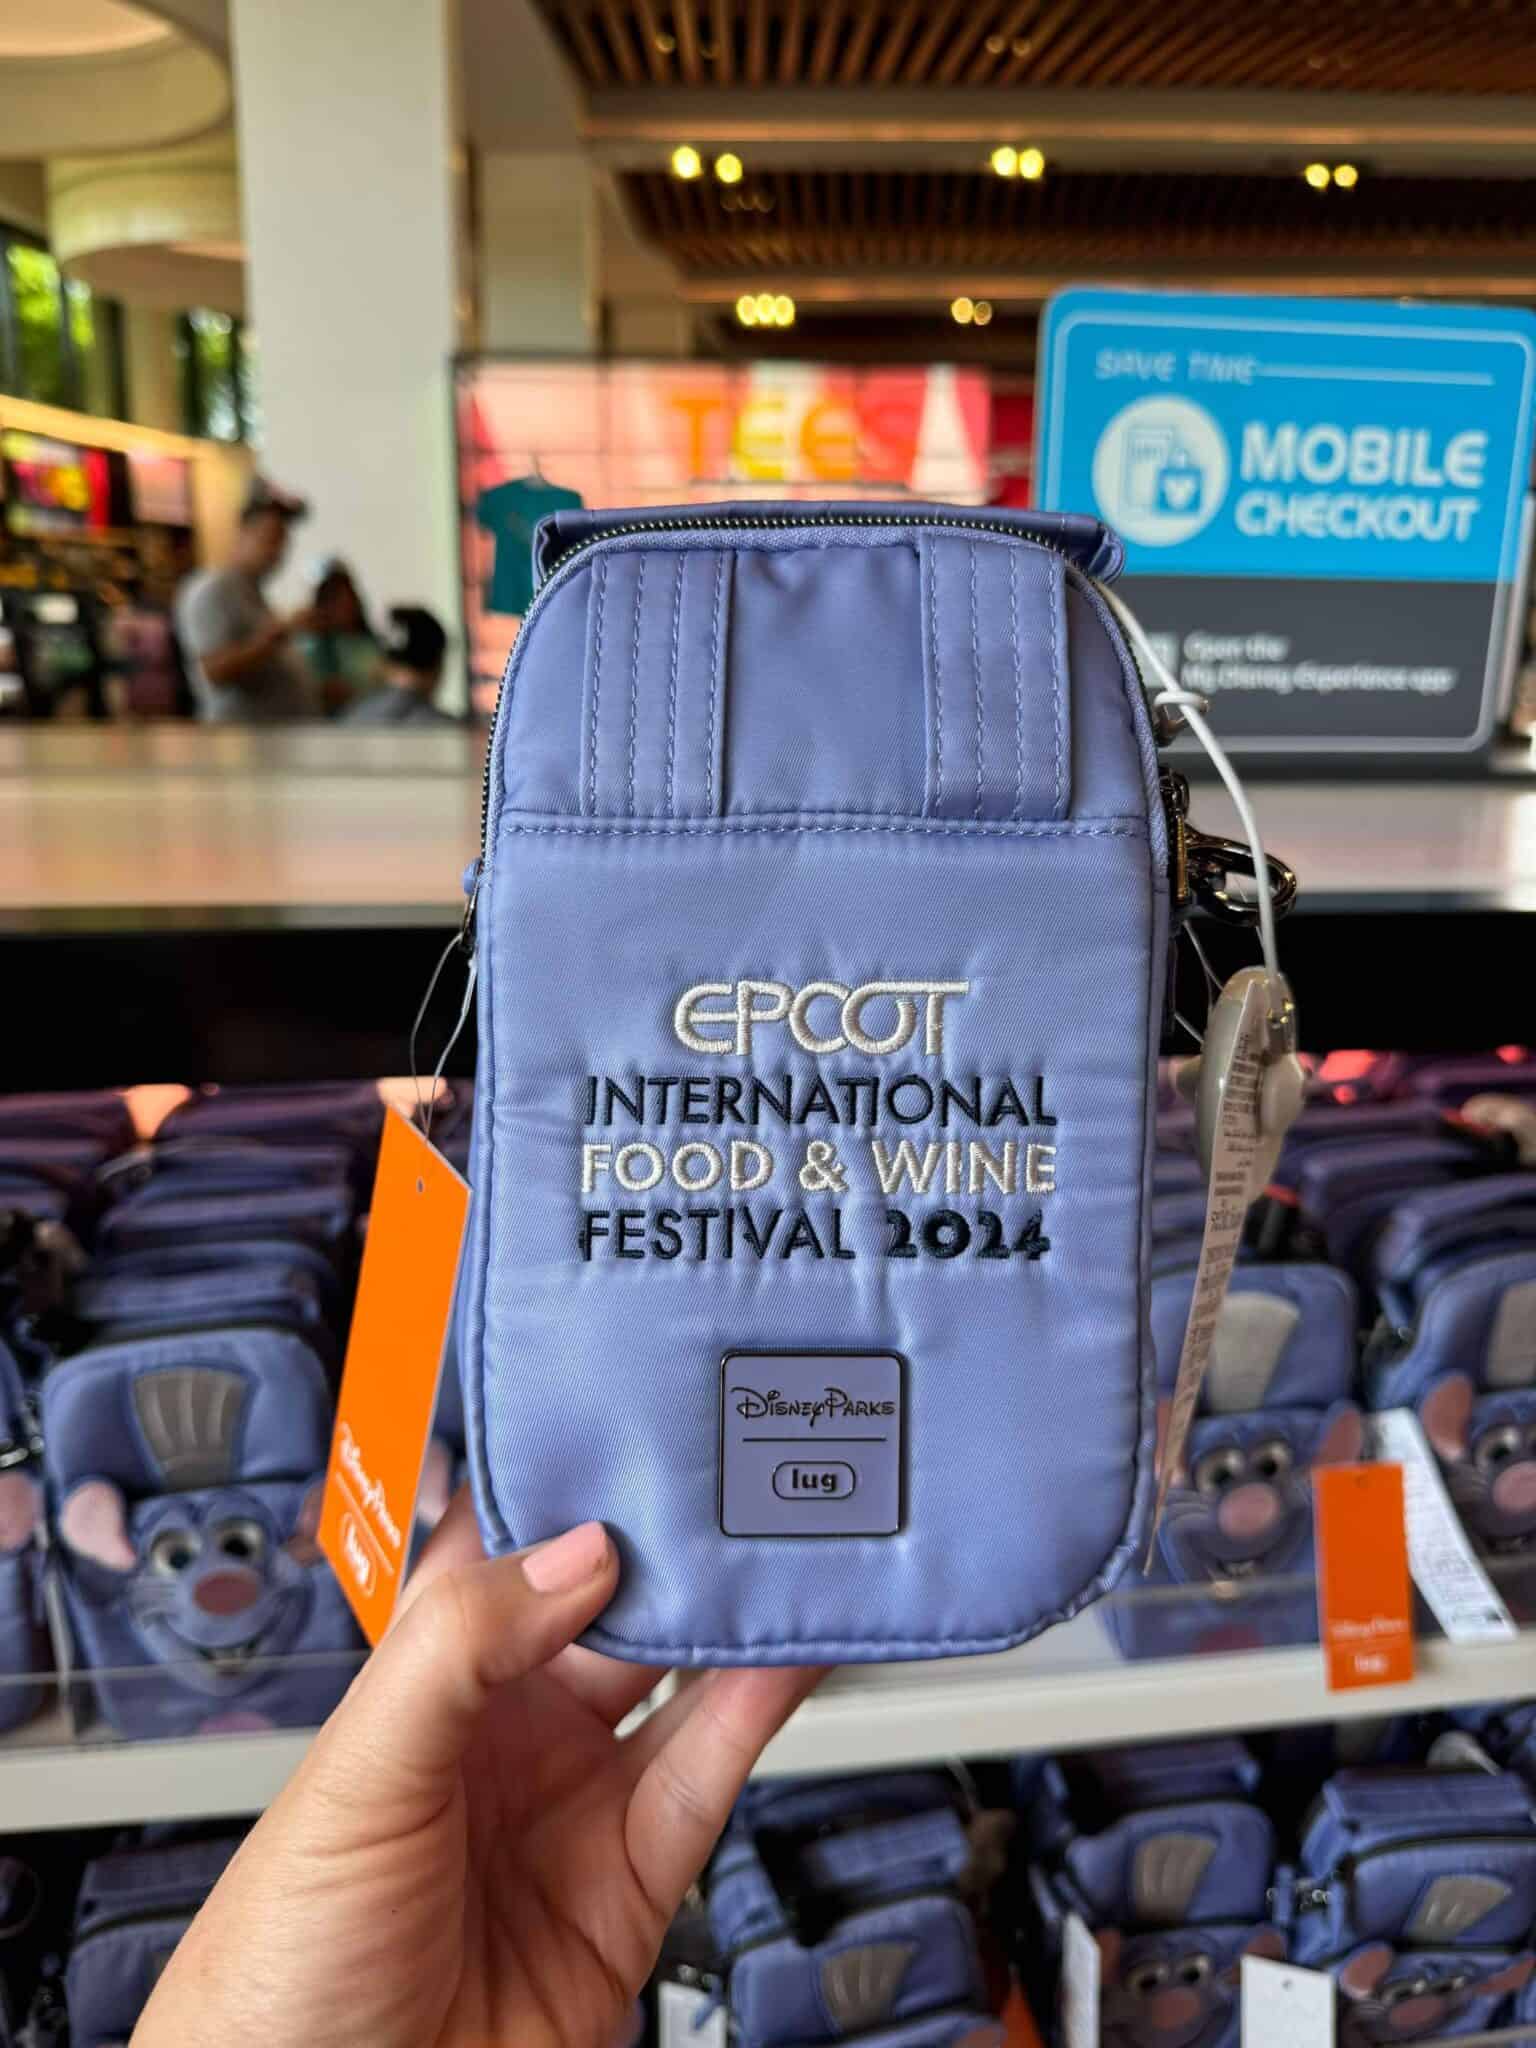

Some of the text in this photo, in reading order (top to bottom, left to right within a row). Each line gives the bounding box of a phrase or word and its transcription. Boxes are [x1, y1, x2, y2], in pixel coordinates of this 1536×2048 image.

[1095, 348, 1176, 382] SAVE
[1240, 421, 1489, 488] MOBILE
[1234, 490, 1480, 541] CHECKOUT
[674, 980, 970, 1055] EPCOT
[584, 1074, 1057, 1128] INTERNATIONAL
[581, 1140, 1057, 1194] FOOD & WINE
[578, 1206, 1051, 1261] FESTIVAL 2024
[791, 1468, 837, 1493] lug
